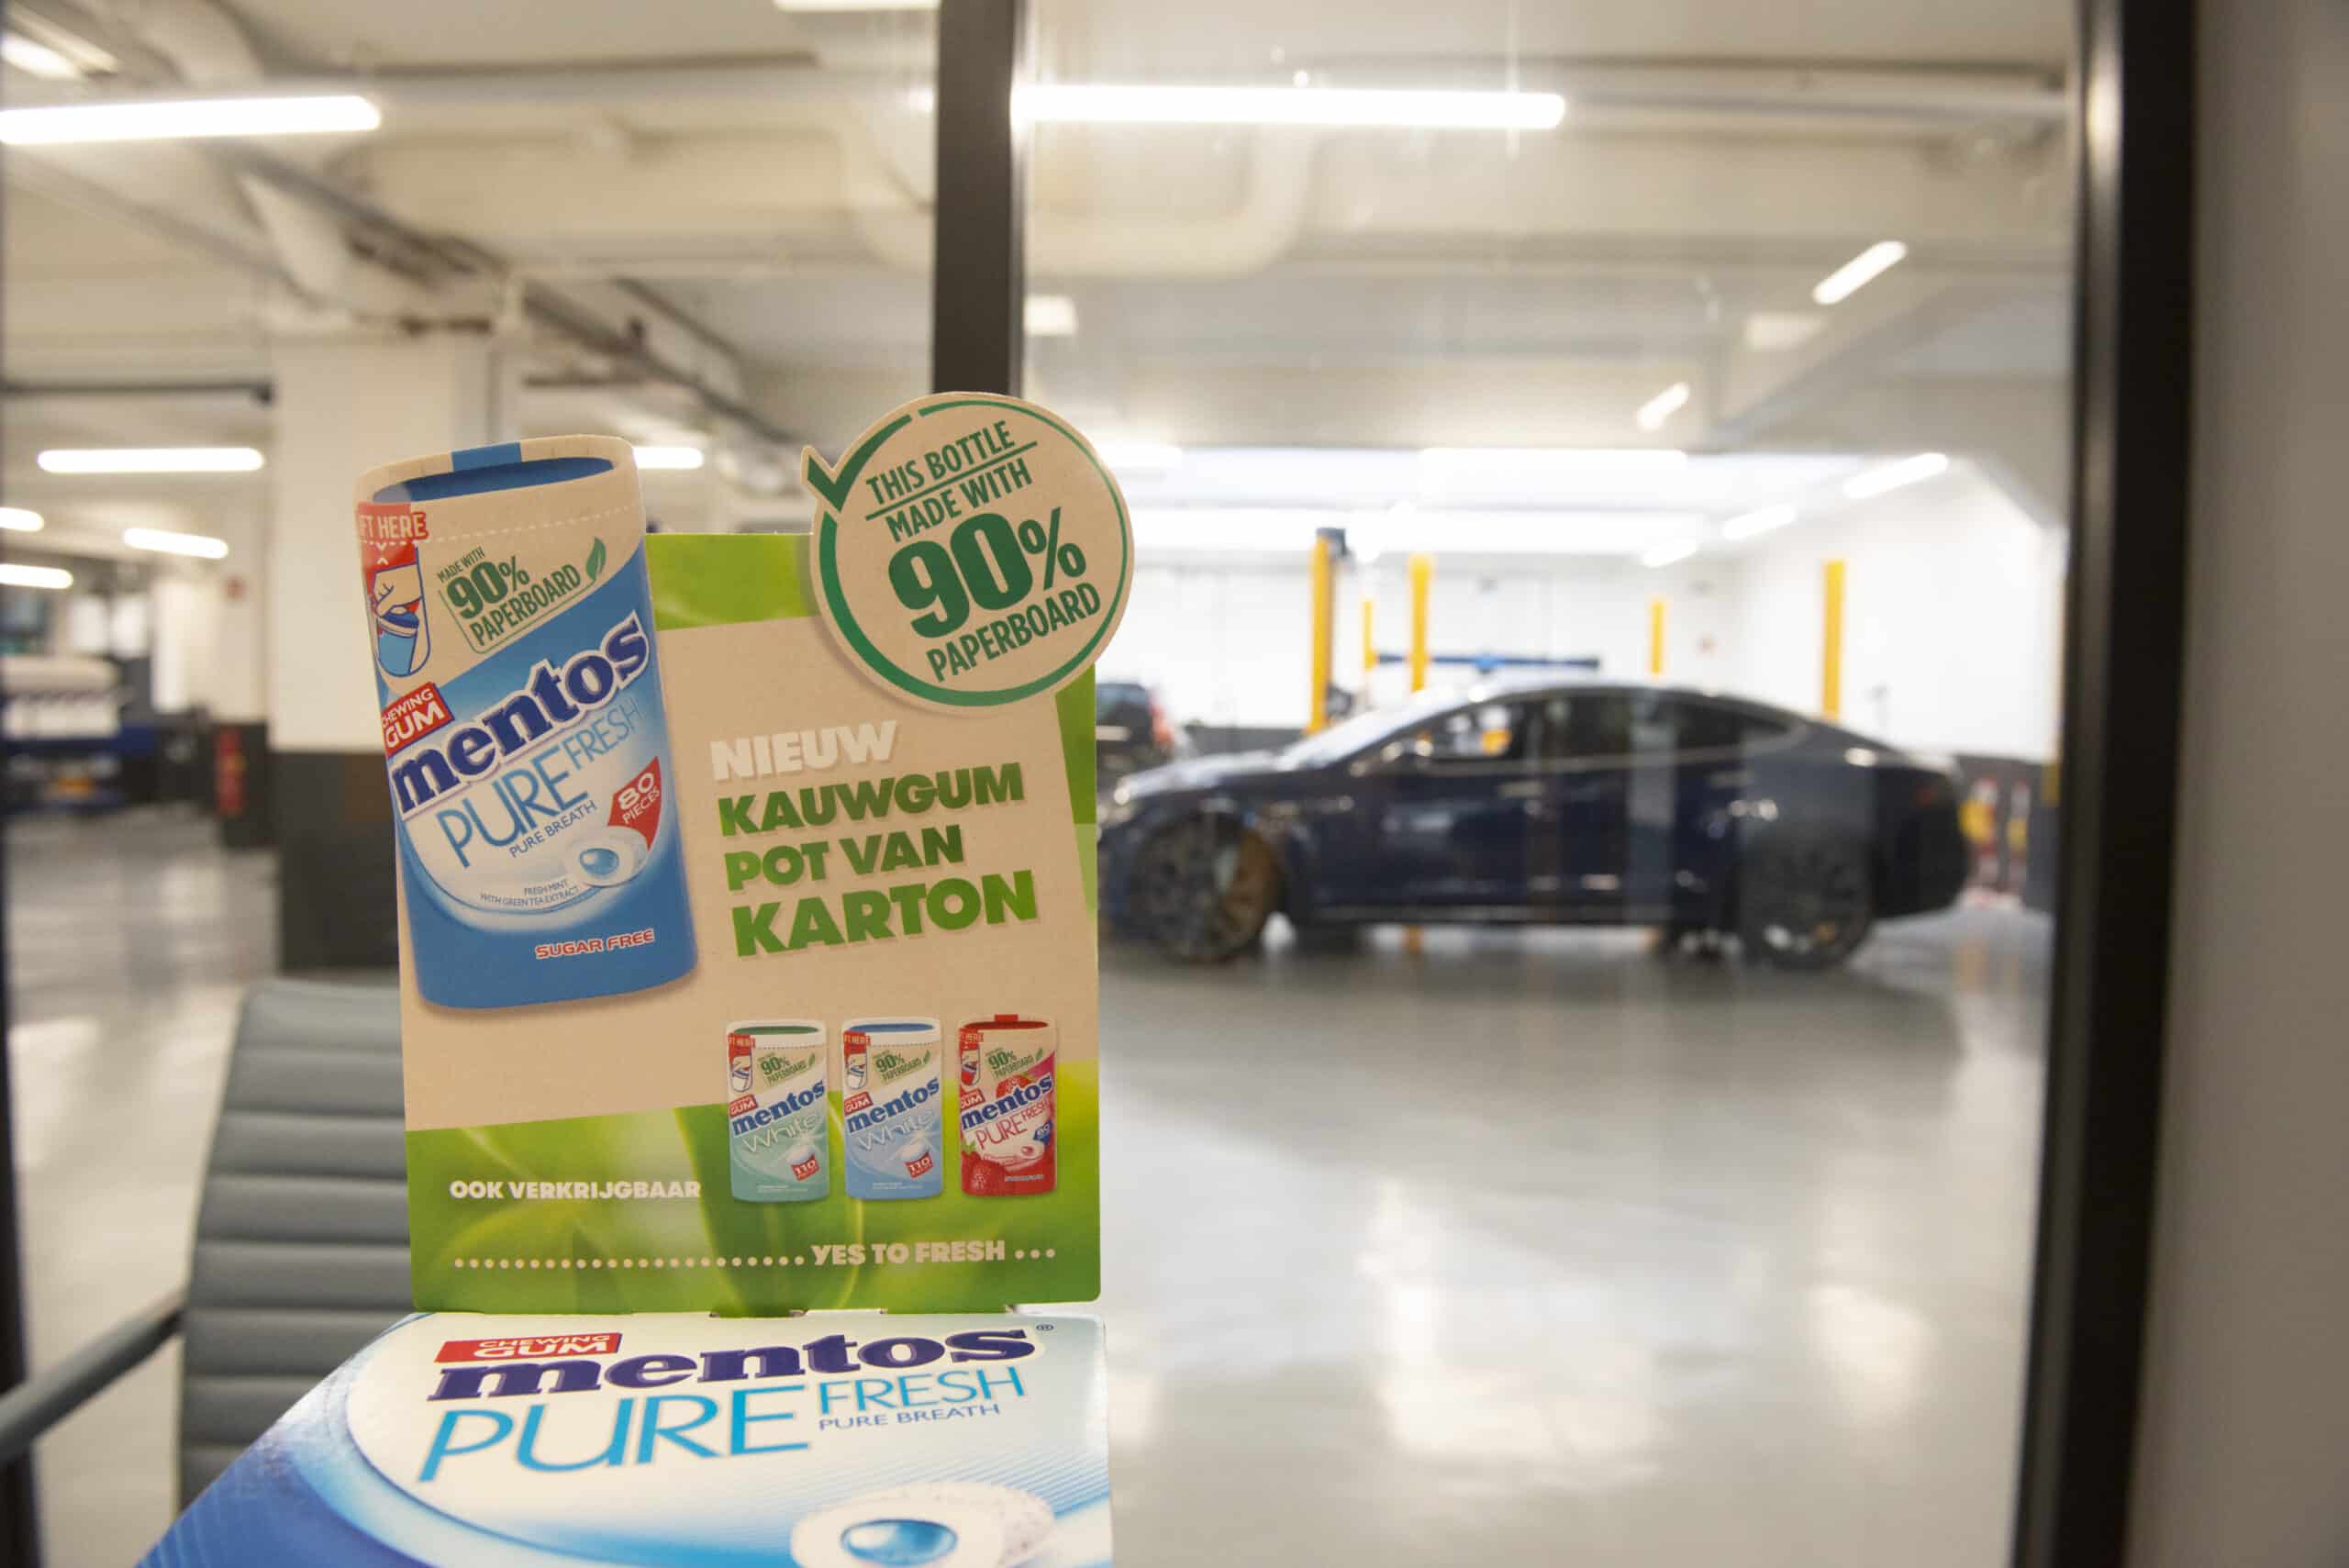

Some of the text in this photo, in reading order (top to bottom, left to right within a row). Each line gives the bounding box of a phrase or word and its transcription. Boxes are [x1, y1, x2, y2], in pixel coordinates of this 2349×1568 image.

[866, 420, 1016, 506] THIS BOTTLE
[377, 513, 428, 539] HERE
[885, 457, 1033, 542] MADE WITH
[437, 546, 485, 583] MADE WITH
[446, 554, 530, 618] 90%
[888, 506, 1087, 639] 90%
[469, 563, 581, 646] PAPERBOARD
[926, 583, 1101, 683] PAPERBOARD
[385, 700, 446, 749] GUM
[390, 614, 651, 817] mentos
[709, 720, 897, 781] NIEUW
[436, 696, 640, 869] PURE FRESH
[618, 772, 655, 810] 80
[622, 784, 661, 824] PIECES
[718, 762, 1025, 838] KAUWGUM
[509, 798, 597, 859] PURE BREATH
[724, 824, 964, 892] POT VAN
[732, 869, 1039, 957] KARTON
[535, 928, 655, 960] SUGAR FREE
[731, 1079, 825, 1136] mentos
[846, 1077, 940, 1134] mentos
[961, 1074, 1052, 1131] mentos
[975, 1116, 1028, 1151] PURE
[449, 1180, 702, 1200] OOK VERKRIJGBAAR
[810, 1240, 1006, 1266] YES TO FRESH
[426, 1329, 1036, 1402] mentos
[473, 1341, 608, 1359] GUM
[477, 1335, 610, 1349] CHEWING
[417, 1365, 1025, 1483] PURE FRESH
[819, 1403, 1000, 1431] PURE BREATH
